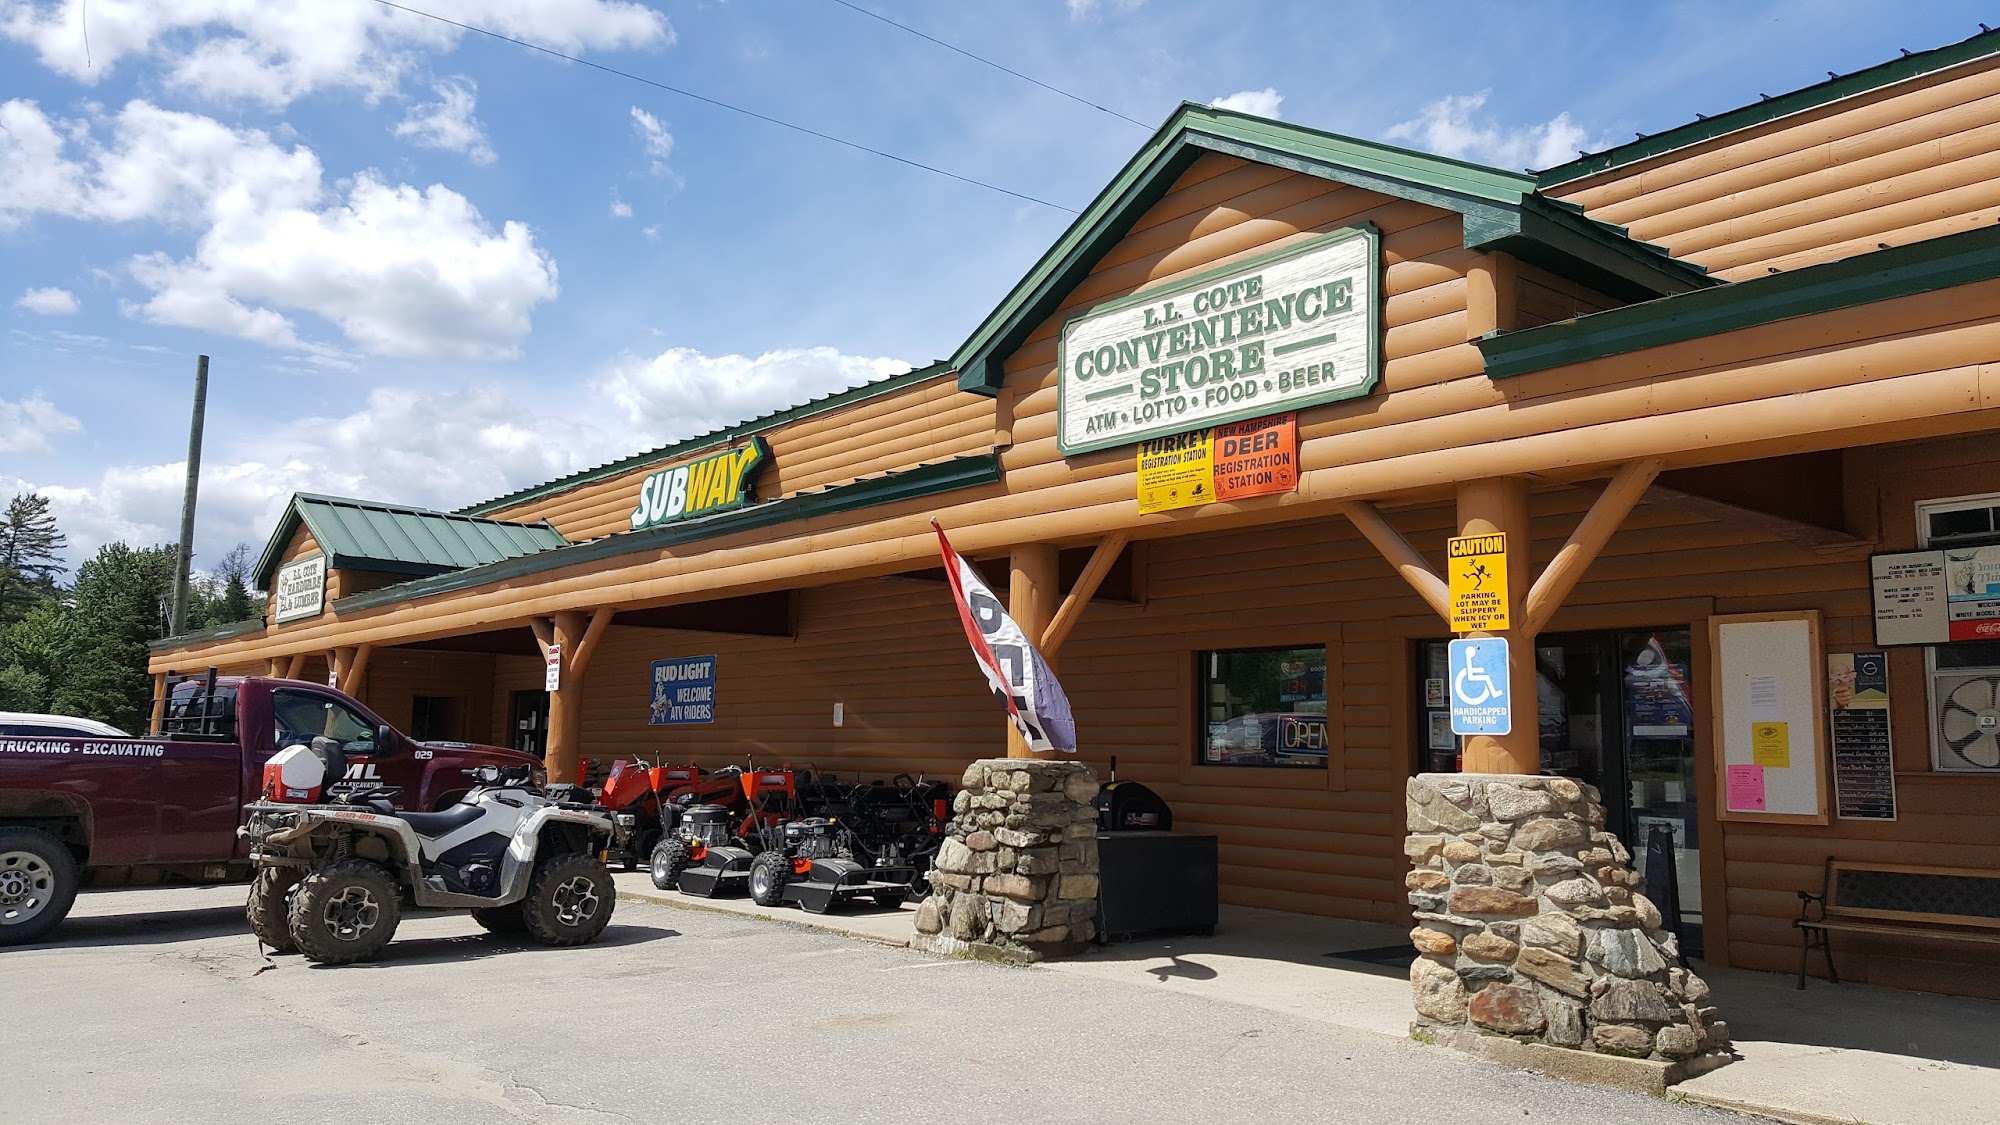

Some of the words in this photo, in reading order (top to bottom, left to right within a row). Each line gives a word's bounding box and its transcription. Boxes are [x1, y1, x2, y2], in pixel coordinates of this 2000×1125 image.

[1144, 303, 1183, 330] L.L.
[1193, 275, 1263, 314] COTE
[1074, 277, 1353, 381] CONVENIENCE
[1140, 340, 1266, 400] STORE
[1086, 411, 1116, 434] ATM
[1133, 395, 1187, 424] LOTTO
[1205, 379, 1258, 408] FOOD
[1278, 361, 1336, 390] BEER
[1217, 424, 1237, 438] NEW
[1238, 415, 1288, 434] HAMPSHIRE
[1142, 428, 1210, 457] TURKEY
[1223, 430, 1279, 458] DEER
[1141, 453, 1181, 471] REGISTRATION
[1183, 448, 1207, 463] STATION
[1213, 452, 1290, 477] REGISTRATION
[631, 443, 758, 528] SUBWAY
[1228, 471, 1272, 490] STATION
[1451, 536, 1503, 556] CAUTION
[303, 564, 317, 577] COTE
[287, 575, 321, 596] HARDWARE
[294, 592, 319, 609] LUMBER
[655, 665, 677, 682] BUD
[678, 662, 710, 680] LIGHT
[677, 686, 712, 702] WELCOME
[670, 706, 683, 720] ATV
[684, 704, 711, 720] RIDERS
[1454, 707, 1507, 716] HANDICAPPED
[1462, 716, 1497, 725] PARKING
[0, 740, 70, 754] TRUCKING
[82, 743, 164, 756] EXCAVATING
[414, 750, 432, 760] 029
[349, 782, 384, 790] EXCAVATING
